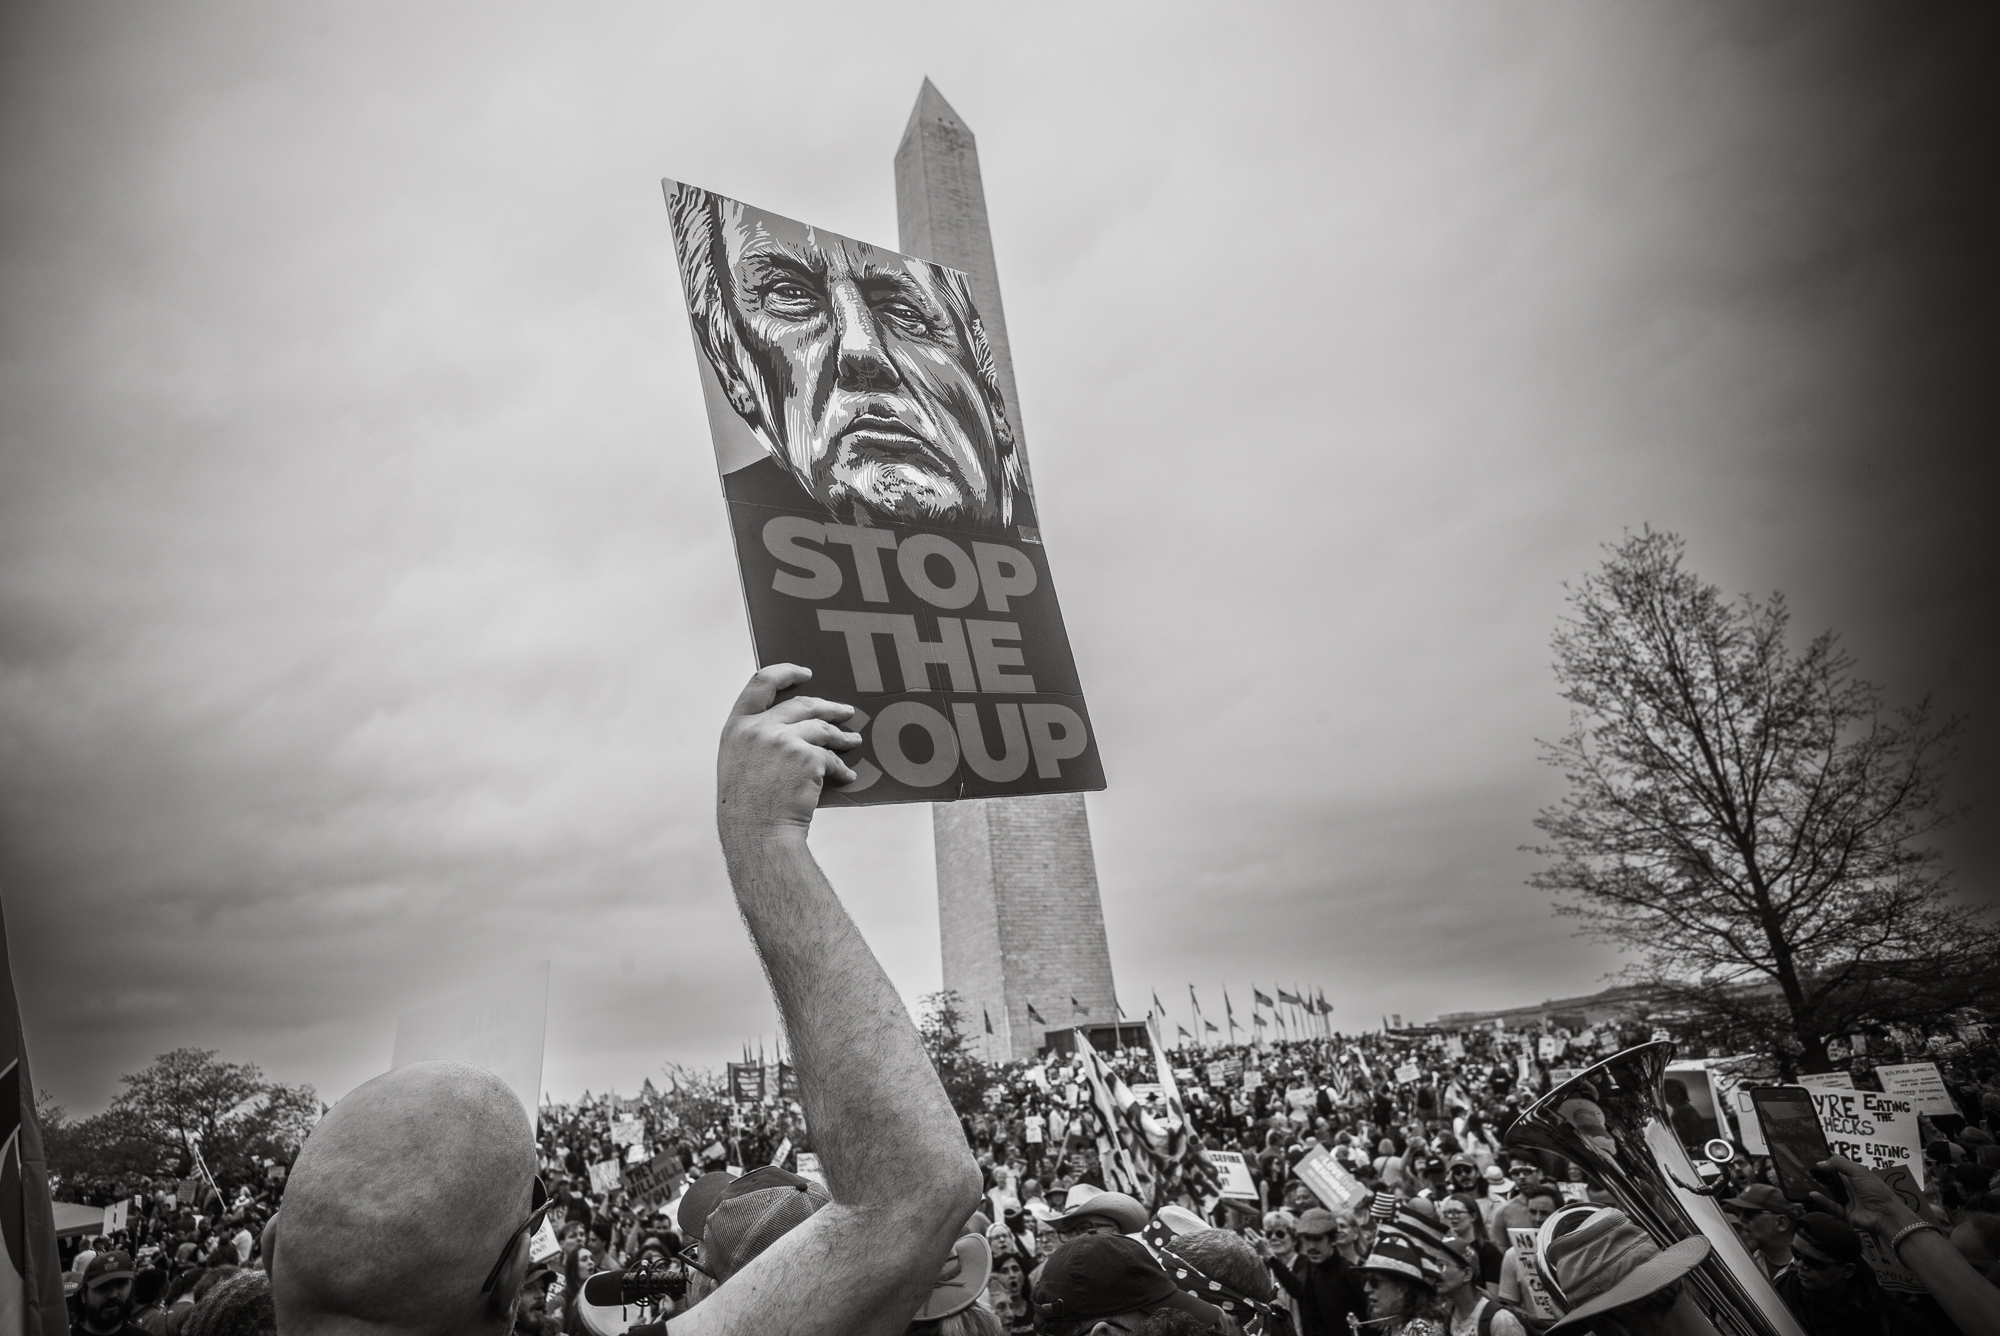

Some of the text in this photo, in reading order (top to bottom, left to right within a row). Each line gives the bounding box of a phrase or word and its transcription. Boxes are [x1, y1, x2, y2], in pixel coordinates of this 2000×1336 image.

[762, 516, 1037, 613] STOP
[816, 609, 1037, 693] THE
[1821, 1117, 1875, 1136] HECKS
[1872, 1112, 1895, 1122] THE
[625, 1161, 654, 1185] THEY
[627, 1162, 684, 1201] WILL KILL
[1309, 1158, 1351, 1201] NEIGHBOR
[641, 1184, 672, 1206] YOU
